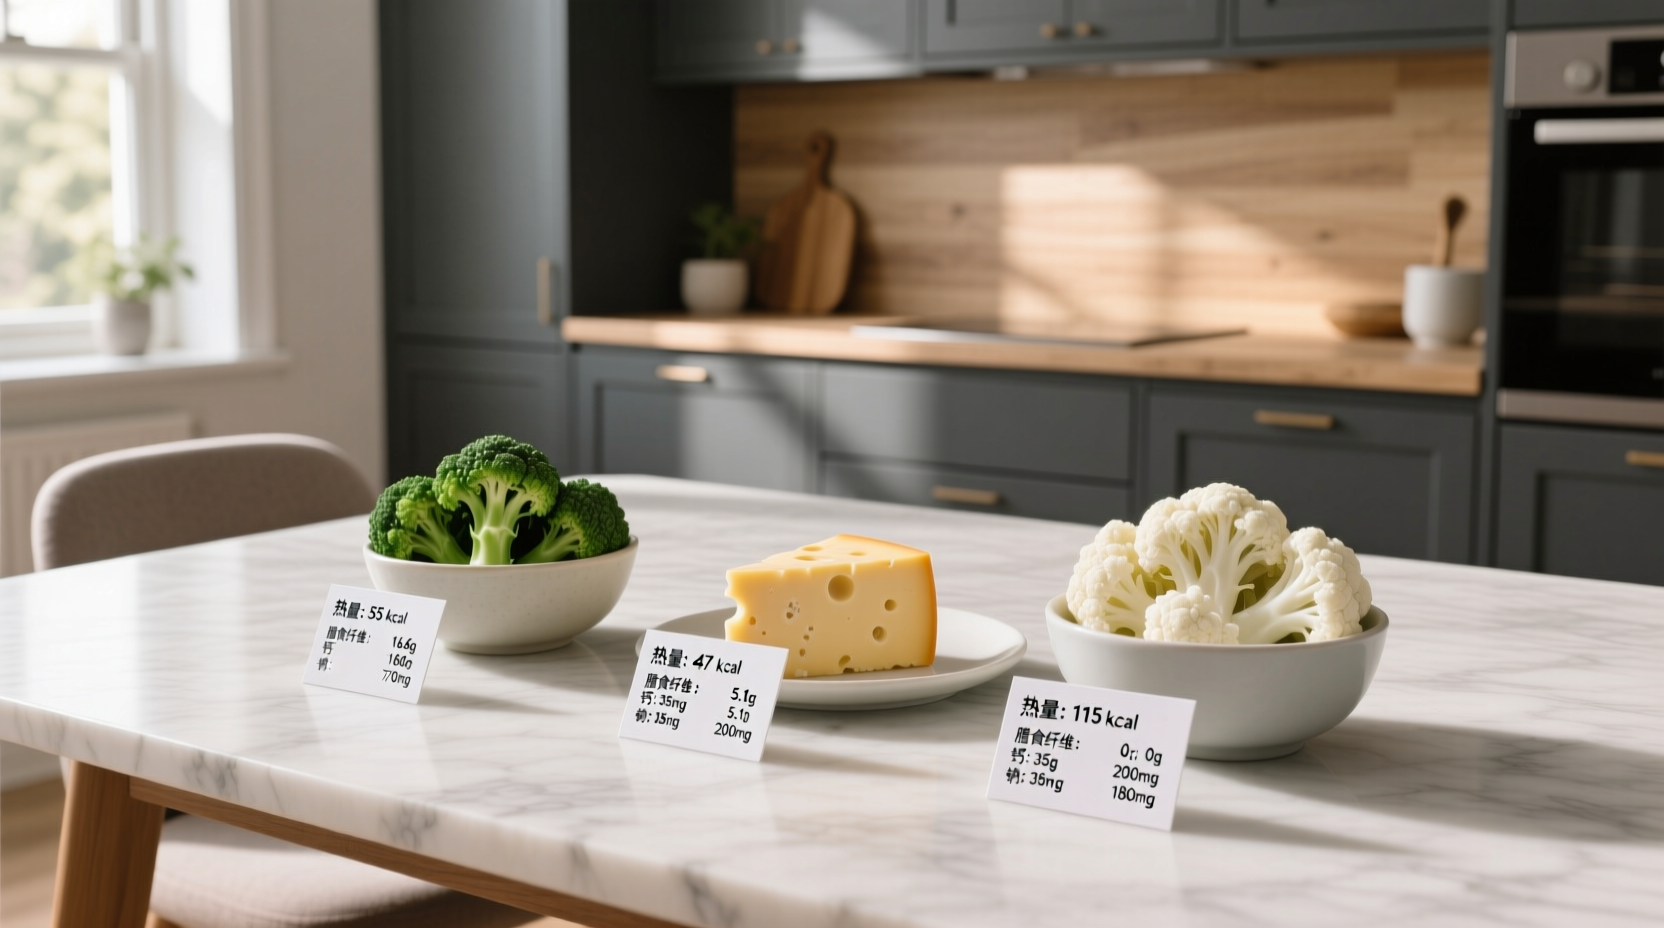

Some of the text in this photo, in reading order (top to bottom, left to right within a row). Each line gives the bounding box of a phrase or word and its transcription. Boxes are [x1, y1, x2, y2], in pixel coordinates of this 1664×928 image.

[367, 605, 385, 621] 55
[385, 609, 409, 624] kcal
[692, 653, 714, 670] 47
[715, 658, 743, 675] kcal
[730, 687, 757, 707] 5.1g
[1019, 695, 1140, 731] 热量: 115 kcal
[713, 722, 752, 744] 200mg
[1033, 752, 1058, 772] 35g
[1112, 763, 1159, 788] 200mg
[1112, 785, 1156, 810] 180mg
